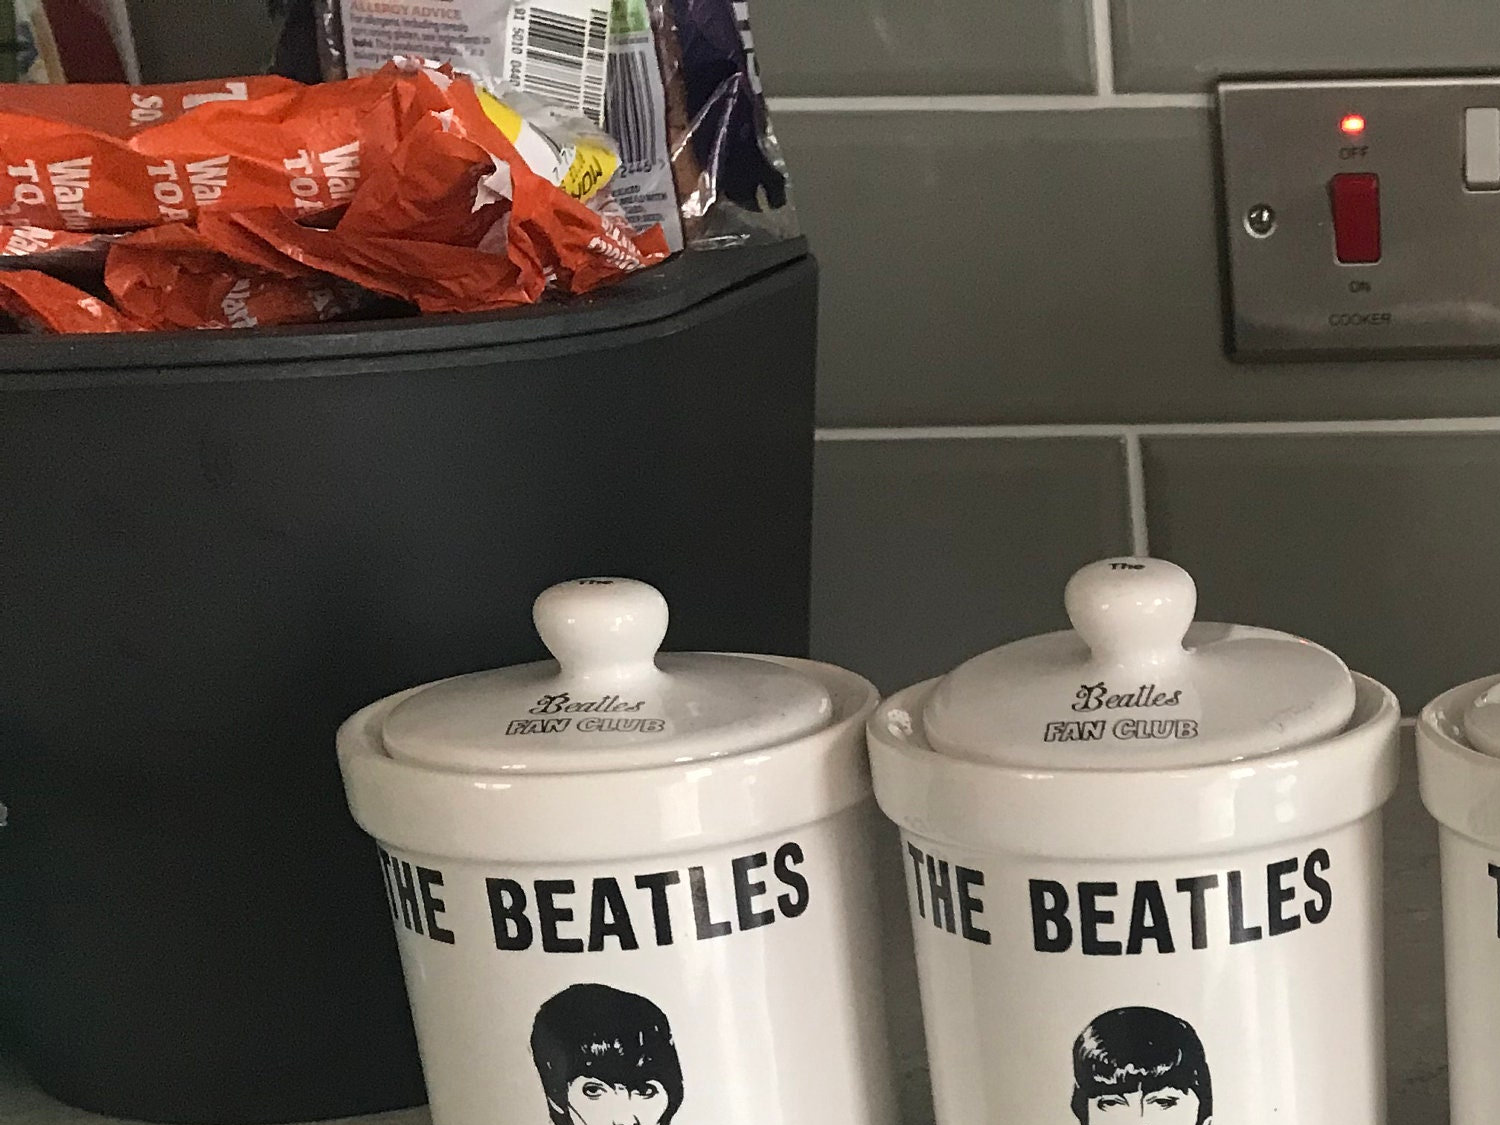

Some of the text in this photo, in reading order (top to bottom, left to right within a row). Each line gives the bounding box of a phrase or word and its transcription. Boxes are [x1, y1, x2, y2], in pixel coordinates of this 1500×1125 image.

[1338, 145, 1369, 160] OFF
[1348, 279, 1372, 293] ON
[1328, 313, 1392, 327] COOKER
[528, 692, 646, 715] Beatles
[1071, 682, 1183, 713] Beatles
[505, 717, 666, 736] FAN CLUB
[1043, 718, 1199, 742] FAN CLUB
[377, 841, 810, 953] THE BEATLES
[906, 840, 1333, 957] THE BEATLES
